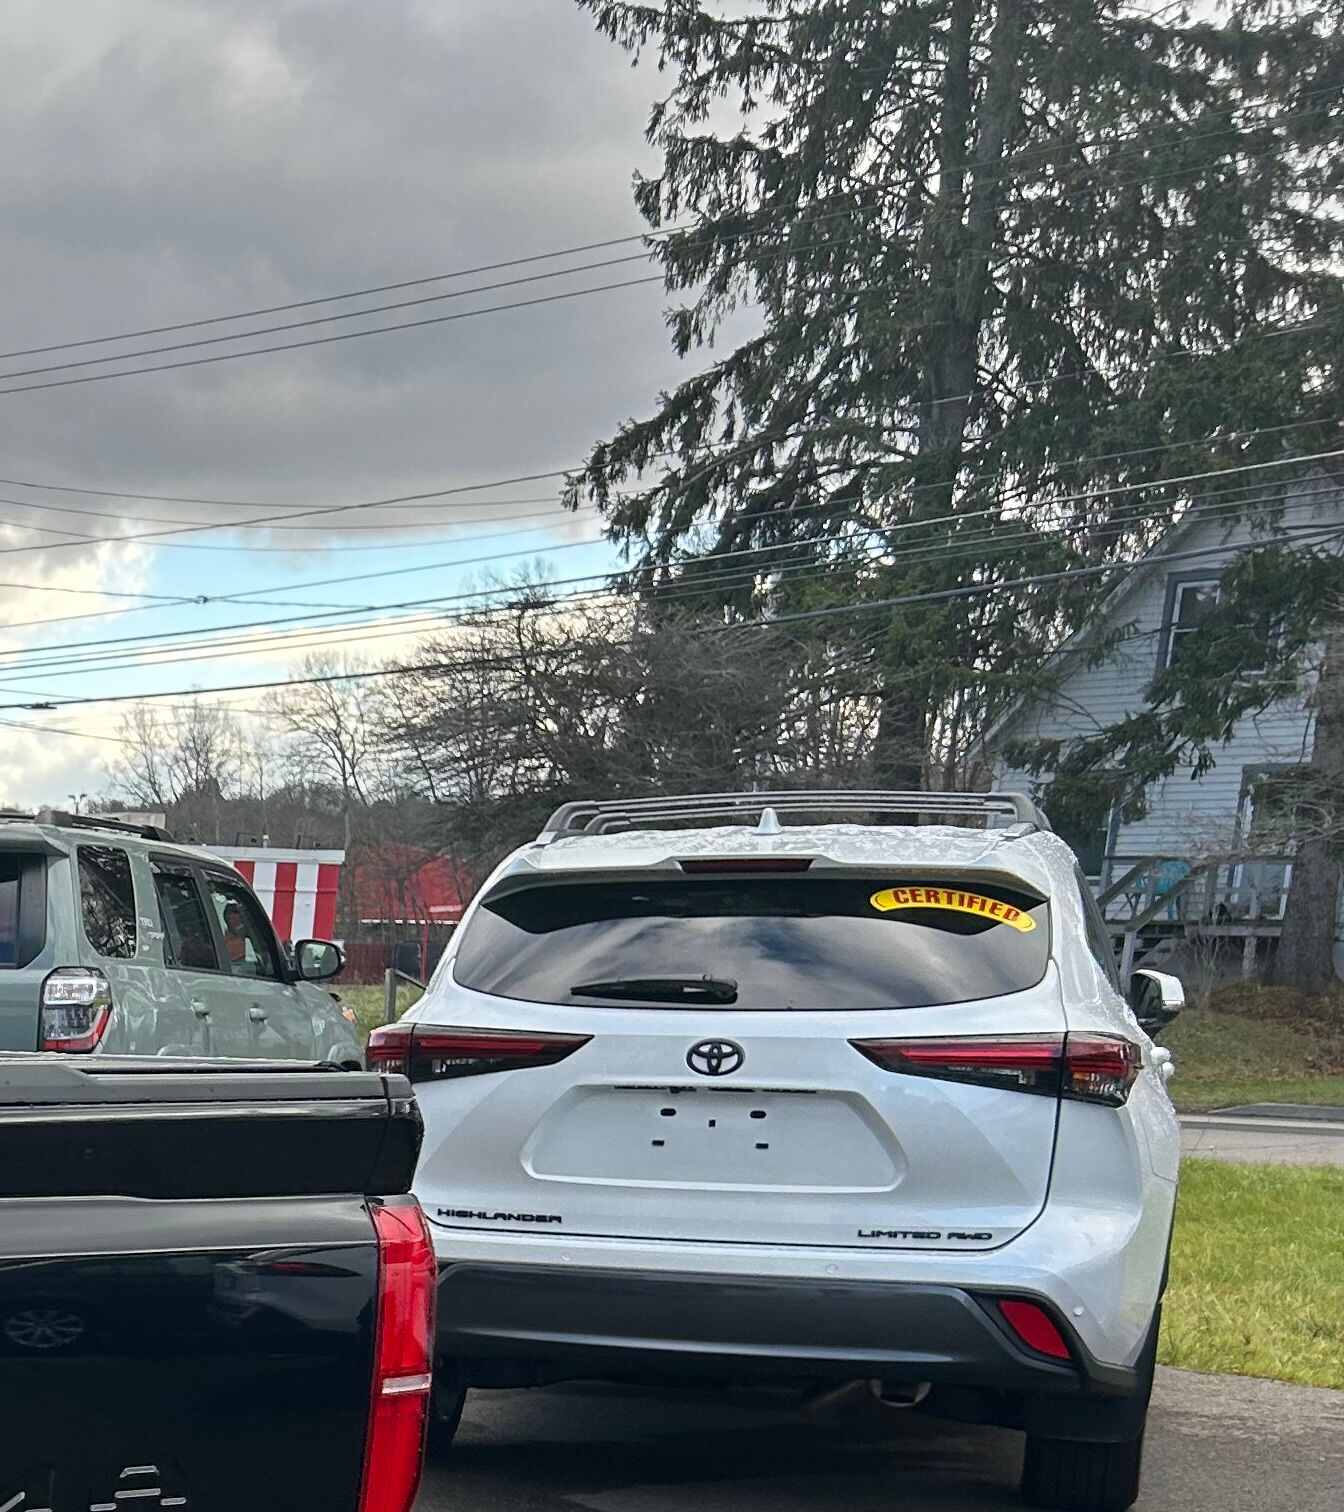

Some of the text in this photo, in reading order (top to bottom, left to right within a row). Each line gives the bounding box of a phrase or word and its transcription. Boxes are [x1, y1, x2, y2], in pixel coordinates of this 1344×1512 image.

[892, 889, 1021, 922] CERTIFIED
[437, 1208, 562, 1223] HIGHLANDER
[857, 1229, 993, 1240] LIMITED AWD
